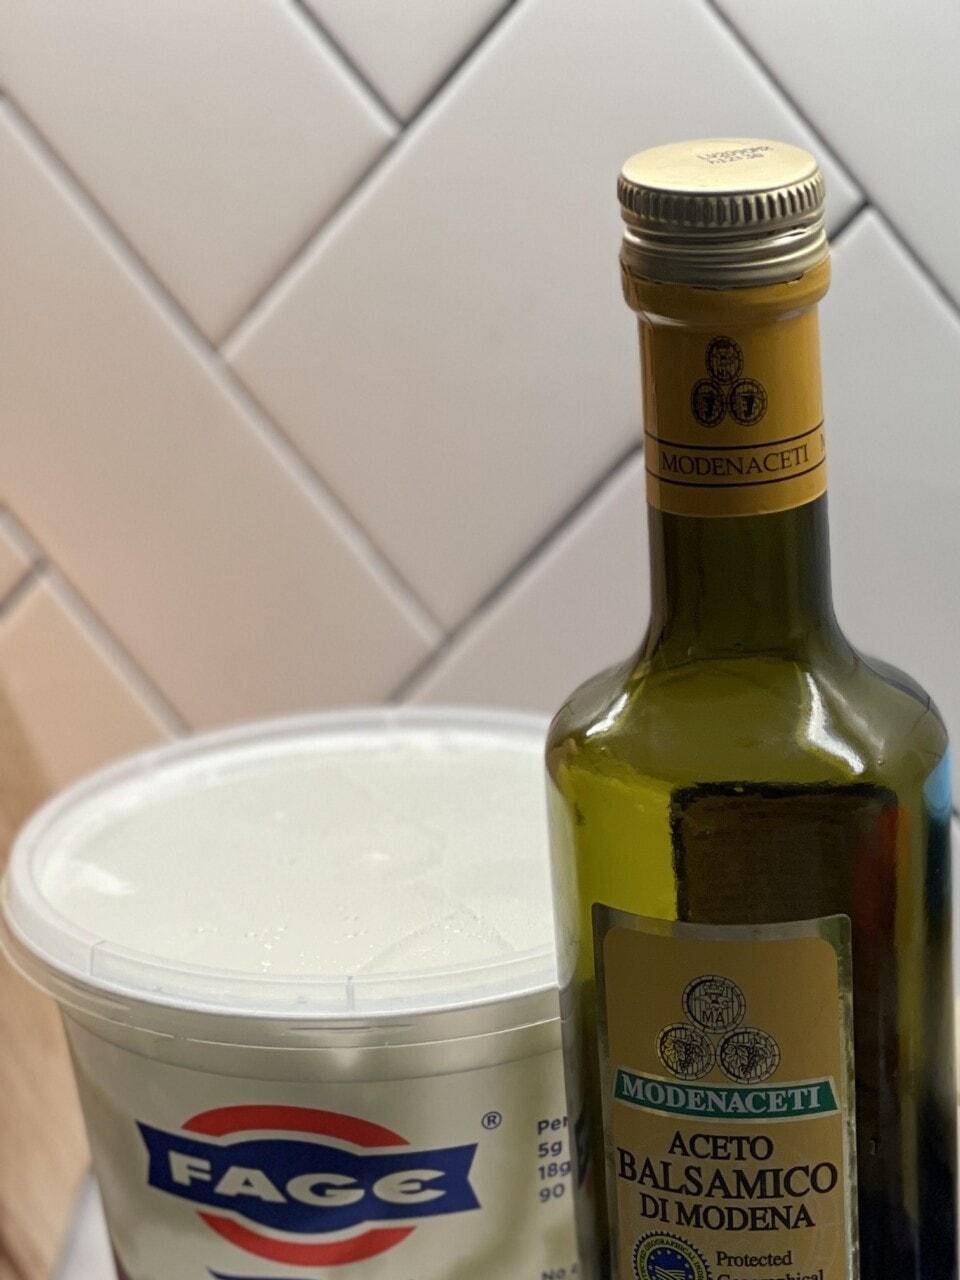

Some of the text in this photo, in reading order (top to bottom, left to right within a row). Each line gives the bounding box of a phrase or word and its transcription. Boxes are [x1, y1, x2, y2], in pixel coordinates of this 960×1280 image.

[661, 443, 809, 476] MODENACETI
[620, 1073, 821, 1114] MODENACETI
[538, 1140, 563, 1158] 5g
[667, 1130, 774, 1161] ACETO
[616, 1146, 839, 1200] BALSAMICO
[539, 1182, 566, 1204] 90
[639, 1192, 816, 1231] DI MODENA
[644, 1238, 696, 1263] GEOGRAPHICAL
[716, 1250, 793, 1267] Protected
